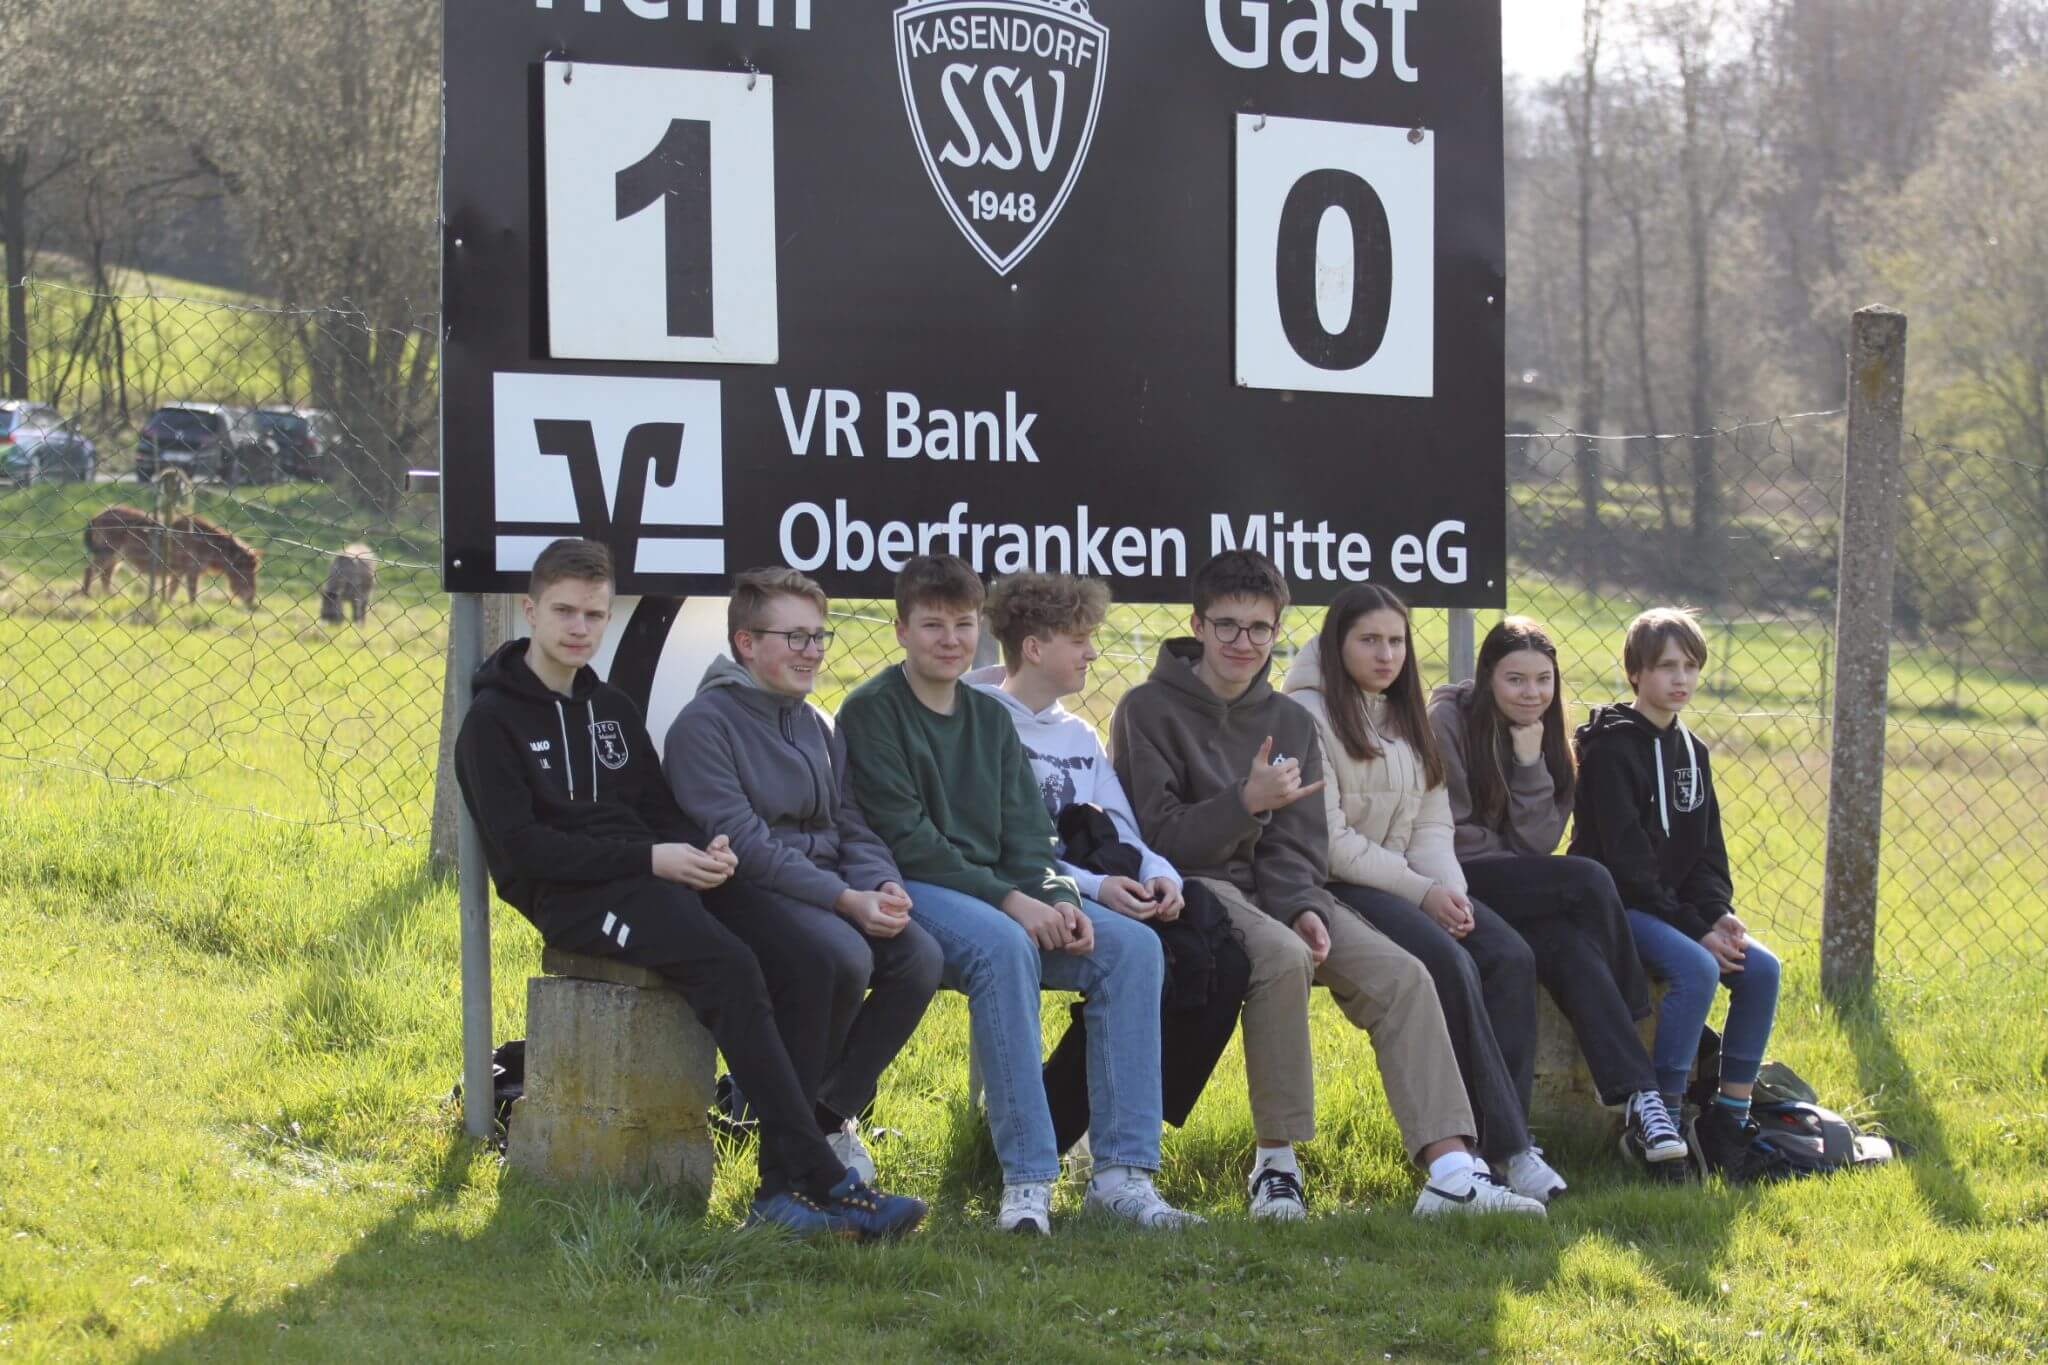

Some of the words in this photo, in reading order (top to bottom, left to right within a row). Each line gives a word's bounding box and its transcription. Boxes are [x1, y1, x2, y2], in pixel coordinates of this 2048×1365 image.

[908, 16, 1095, 69] KASENDORF
[1205, 0, 1418, 82] Gast
[939, 63, 1065, 172] SSV
[616, 118, 714, 338] 1
[968, 190, 1036, 223] 1948
[1276, 168, 1392, 371] 0
[775, 387, 864, 457] VR
[887, 389, 1040, 463] Bank
[779, 498, 1187, 577] Oberfranken
[1211, 512, 1371, 582] Mitte
[1391, 520, 1467, 584] eG
